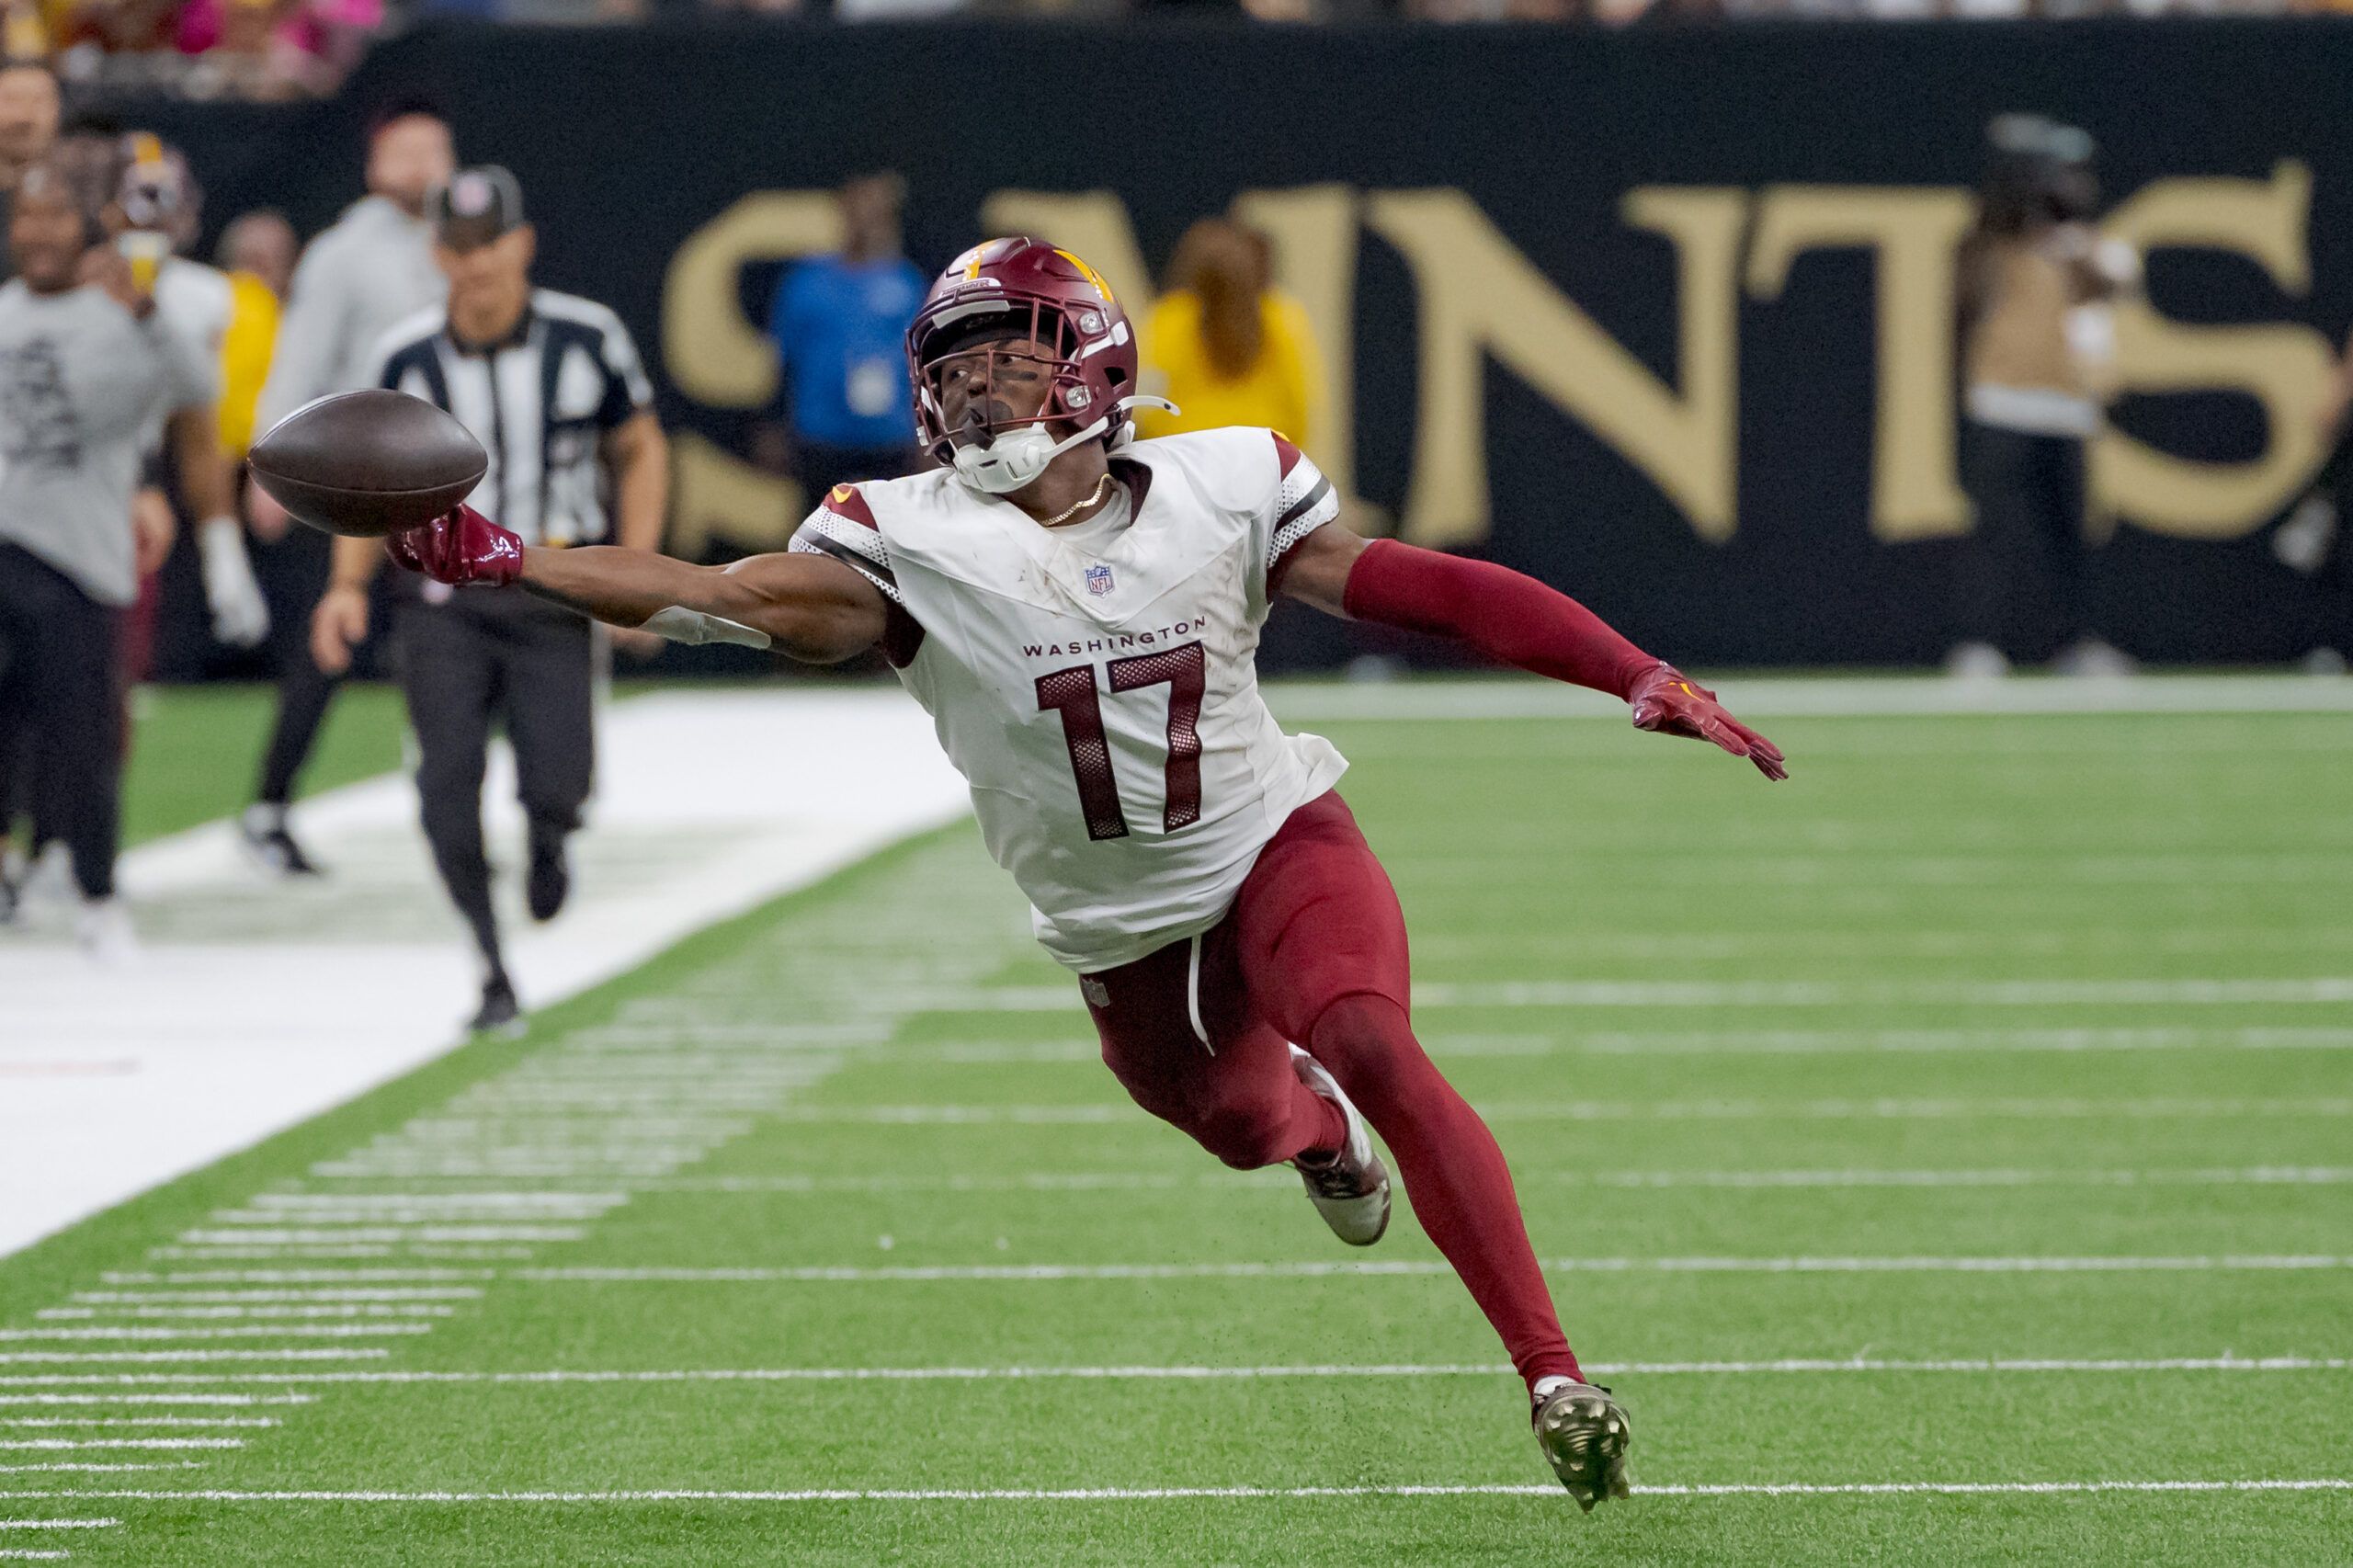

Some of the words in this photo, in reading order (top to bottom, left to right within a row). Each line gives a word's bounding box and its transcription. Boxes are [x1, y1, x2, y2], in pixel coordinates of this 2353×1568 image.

[1091, 577, 1112, 591] NFL
[1023, 616, 1206, 657] WASHINGTON
[1034, 640, 1206, 841] 17
